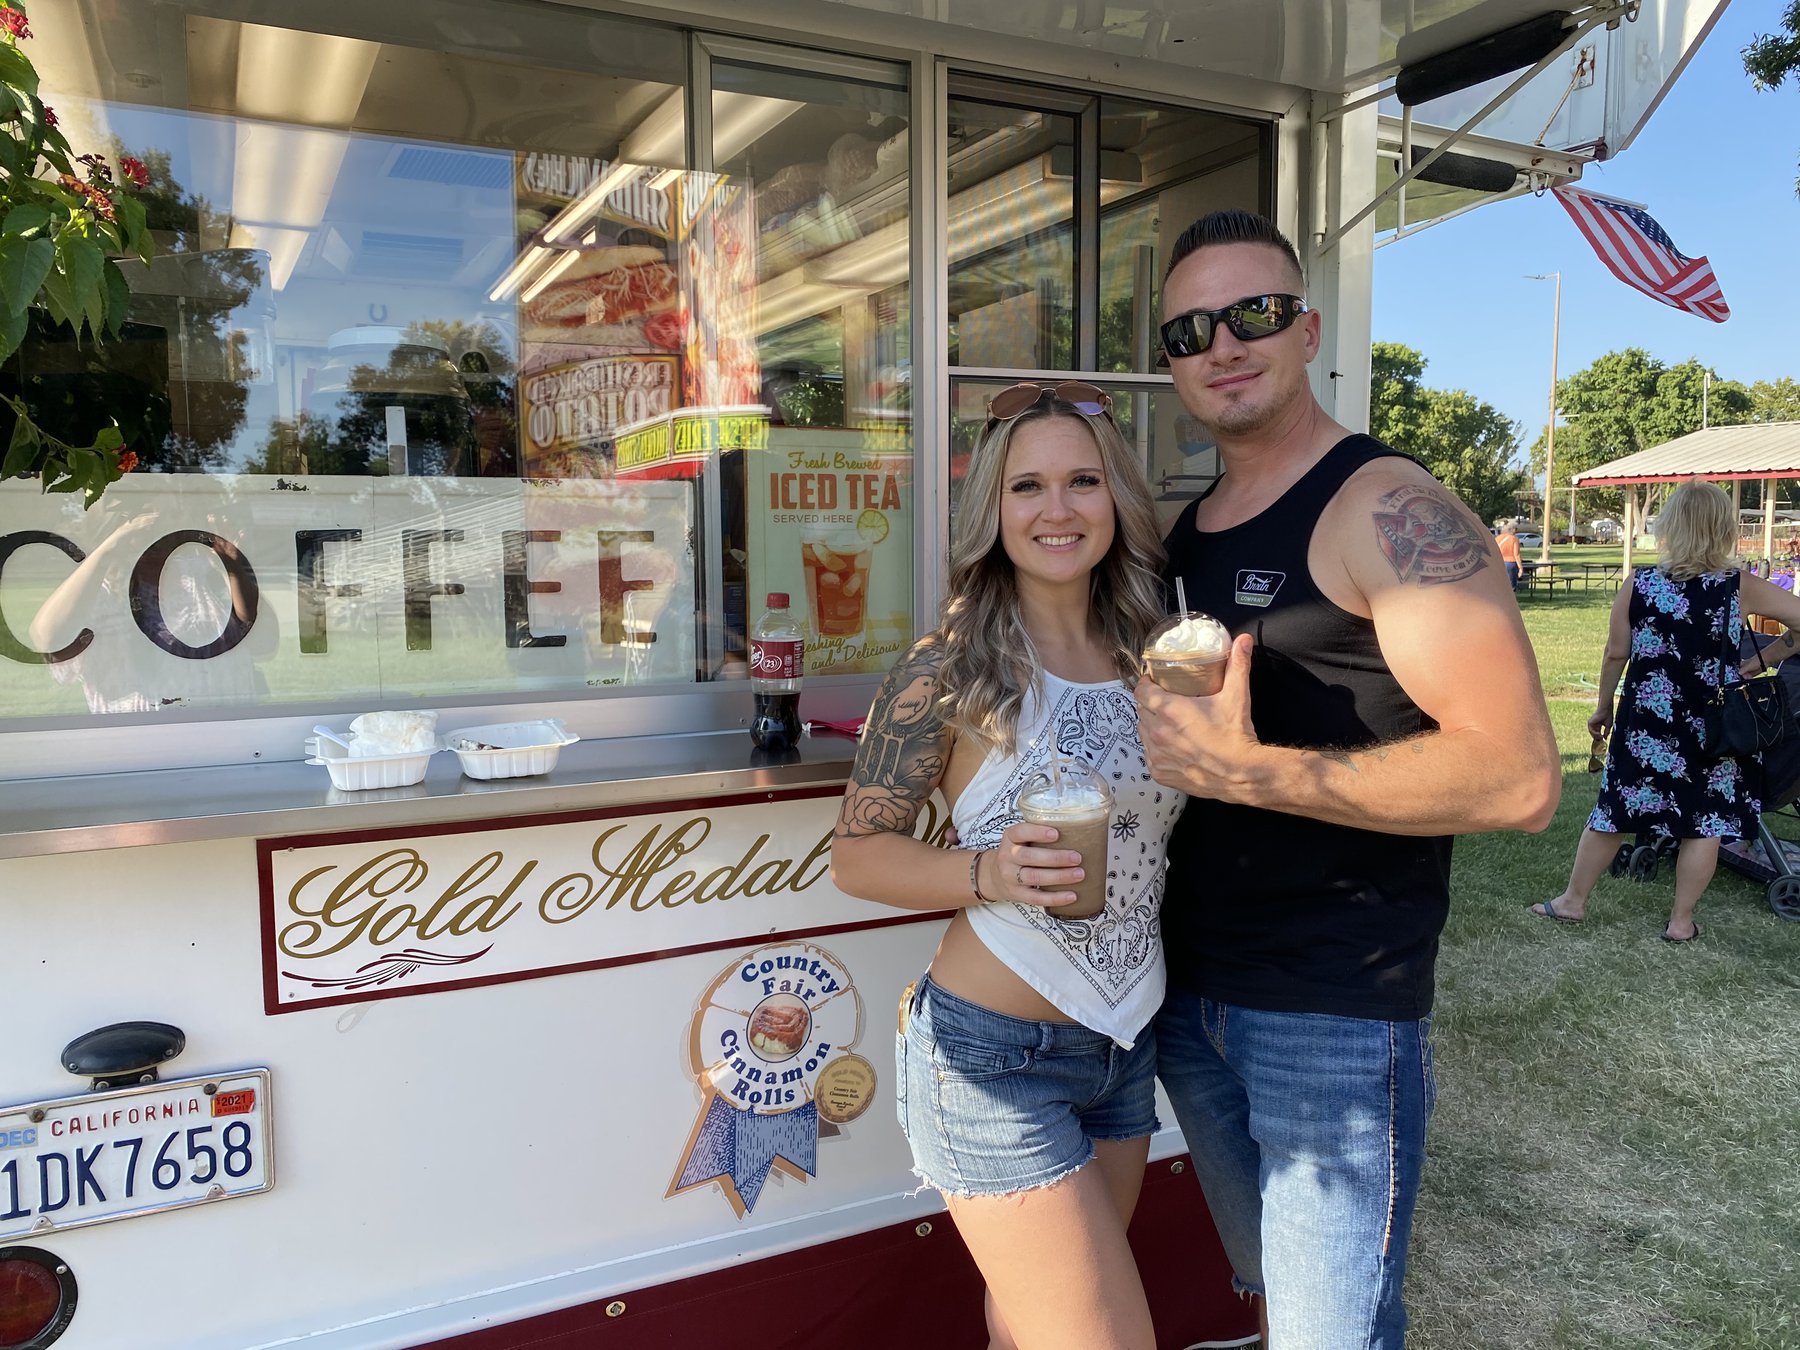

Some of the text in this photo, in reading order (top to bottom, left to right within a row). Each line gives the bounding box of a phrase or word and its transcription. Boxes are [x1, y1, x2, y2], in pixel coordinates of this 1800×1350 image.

[789, 452, 882, 471] Fresh Brewed
[770, 473, 901, 510] ICED TEA
[773, 514, 853, 523] SERVED HERE
[0, 529, 657, 664] COFFEE
[804, 634, 845, 653] eshing
[811, 650, 836, 670] and
[843, 643, 899, 662] Delicious
[279, 848, 538, 959] Gold
[538, 817, 834, 924] Medal
[741, 955, 840, 995] Country
[762, 977, 816, 1000] Fair
[720, 1029, 831, 1085] Cinnamon
[221, 1094, 246, 1107] 2021
[731, 1078, 795, 1105] Rolls
[51, 1098, 199, 1137] CALIFORNIA
[0, 1128, 36, 1148] DEC
[1, 1121, 251, 1221] 1DK7658
